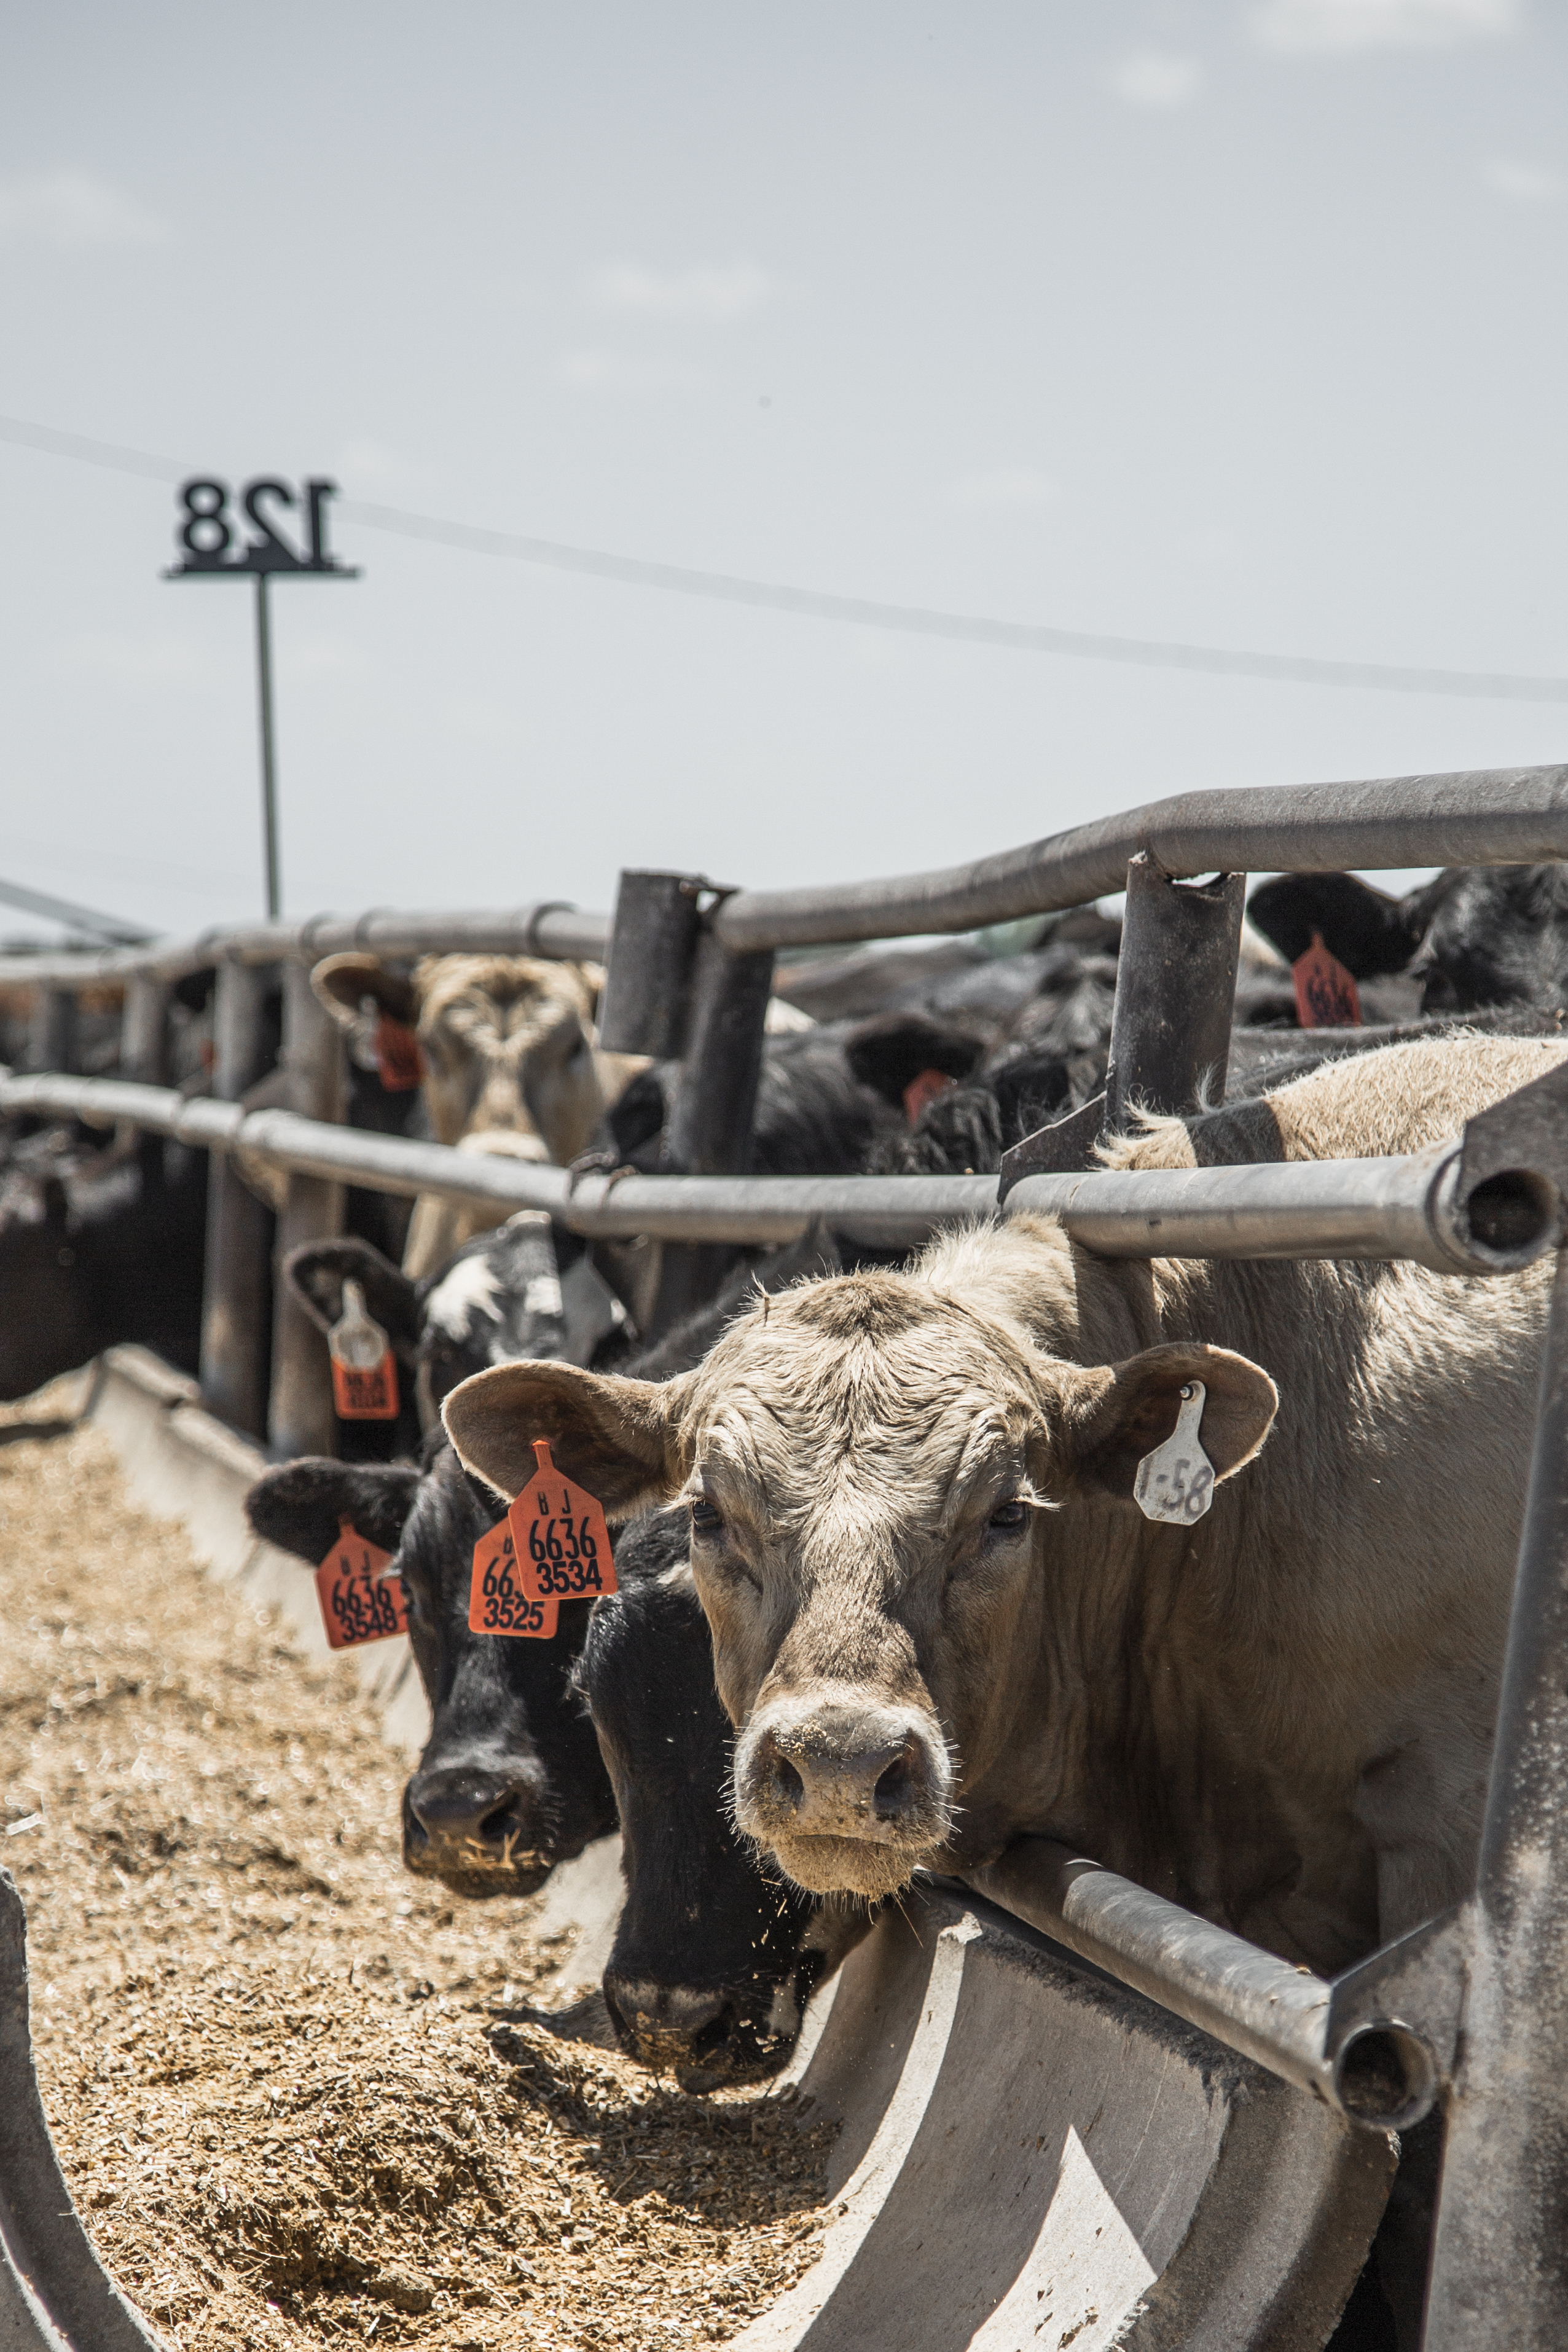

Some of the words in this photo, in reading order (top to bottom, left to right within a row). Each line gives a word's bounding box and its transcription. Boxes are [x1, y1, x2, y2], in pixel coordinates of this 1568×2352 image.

[529, 1516, 597, 1562] 6636
[332, 1574, 391, 1615] 6636
[536, 1558, 603, 1595] 3534
[340, 1605, 397, 1641] 3548
[483, 1597, 545, 1631] 3525
